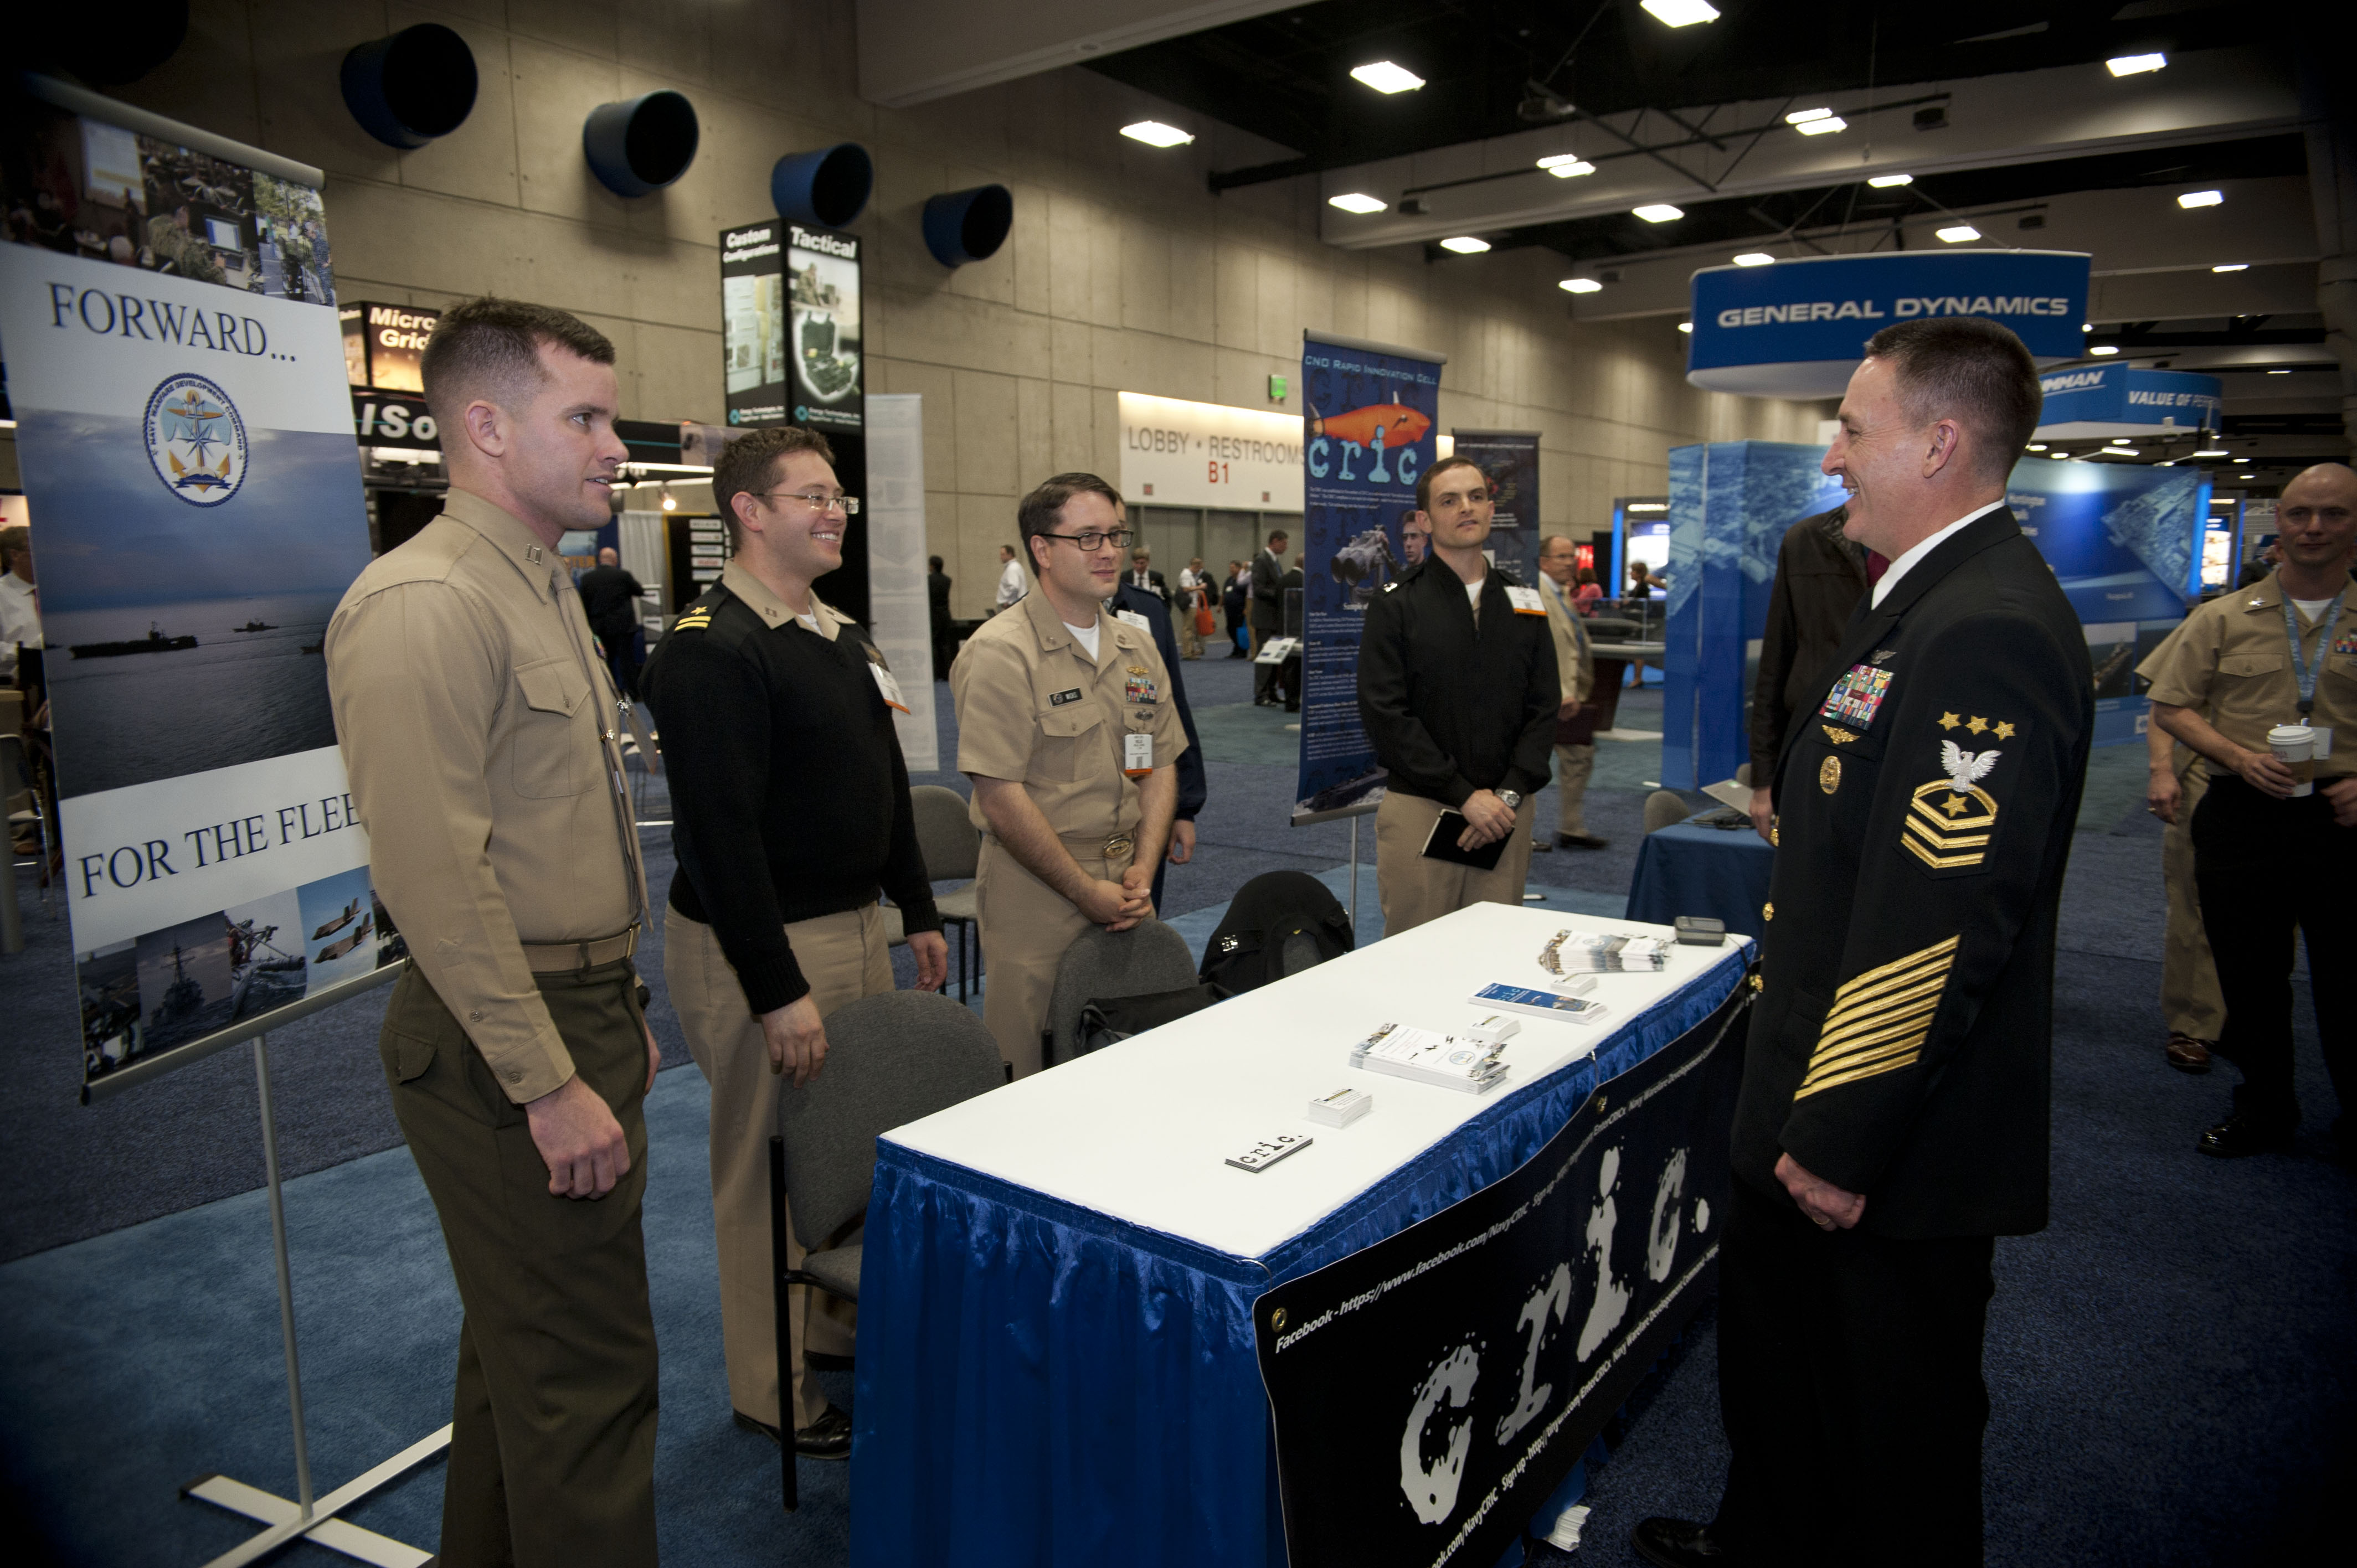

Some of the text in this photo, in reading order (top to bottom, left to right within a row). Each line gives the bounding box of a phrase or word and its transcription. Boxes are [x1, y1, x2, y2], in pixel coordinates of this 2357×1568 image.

[726, 228, 771, 249] Custom
[790, 226, 857, 259] Tactical
[47, 281, 297, 363] FORWARD...
[369, 307, 438, 332] Micro
[1717, 296, 2070, 328] GENERAL DYNAMICS
[1305, 355, 1330, 368] CNO
[2041, 370, 2105, 392] MMAN
[176, 379, 226, 405] DEVELOPMENT
[224, 405, 243, 451] COMMAND
[2128, 391, 2175, 406] VALUE
[1128, 426, 1305, 465] LOBBY RESTROOMS
[1308, 425, 1418, 486] cric
[1208, 461, 1229, 483] B1
[78, 792, 361, 899] FOR THE FLEE
[1275, 1308, 1334, 1354] Facebook
[1339, 1201, 1530, 1317] https://www.facebook.com/NavyCRIC
[1501, 1467, 1517, 1491] Sign
[1516, 1457, 1527, 1474] up
